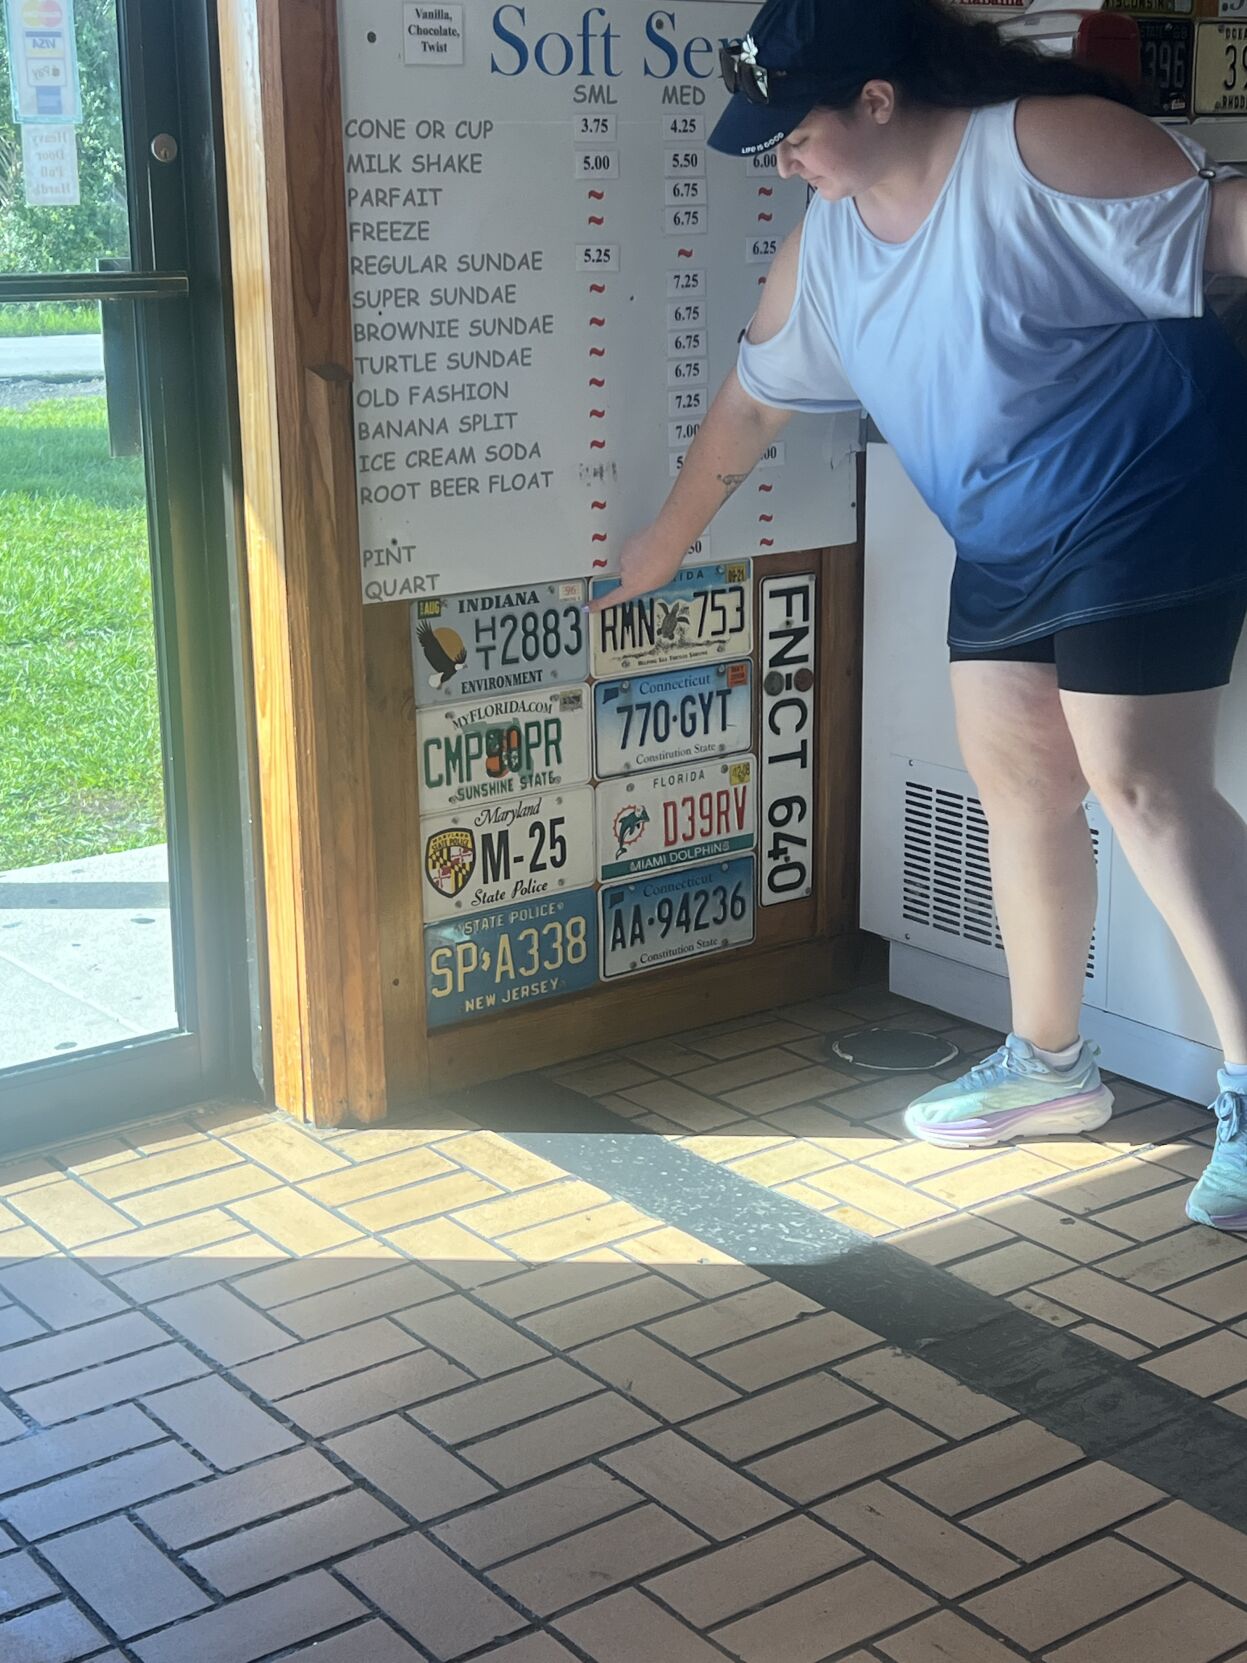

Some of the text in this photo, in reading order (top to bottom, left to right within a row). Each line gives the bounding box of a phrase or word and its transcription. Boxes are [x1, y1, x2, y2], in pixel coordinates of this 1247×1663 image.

[415, 8, 453, 21] Vanilla,
[408, 25, 460, 38] Chocolate,
[491, 4, 623, 77] Soft
[421, 41, 448, 53] Twist
[573, 85, 706, 105] SML MED
[345, 119, 493, 139] CONE OR CUP
[581, 118, 608, 134] 3.75
[670, 119, 696, 134] 4.25
[346, 153, 483, 174] MILK SHAKE
[584, 156, 610, 171] 5.00
[672, 154, 698, 168] 5.50
[753, 154, 777, 168] 6.00
[347, 188, 443, 207] PARFAIT
[673, 183, 698, 197] 6.75
[674, 211, 698, 225] 6.75
[349, 221, 430, 242] FREEZE
[584, 248, 611, 263] 5.25
[752, 241, 776, 255] 6.25
[350, 251, 543, 275] REGULAR SUNDAE
[674, 274, 699, 289] 7.25
[352, 284, 516, 309] SUPER SUNDAE
[675, 307, 699, 321] 6.75
[354, 314, 554, 343] BROWNIE SUNDAE
[675, 335, 699, 349] 6.75
[355, 347, 532, 375] TURTLE SUNDAE
[675, 363, 700, 377] 6.75
[356, 381, 509, 408] OLD FASHION
[675, 394, 700, 408] 7.25
[358, 412, 518, 441] BANANA SPLIT
[675, 424, 700, 440] 7.00
[359, 442, 541, 473] ICE CREAM SODA
[760, 446, 777, 460] .00
[361, 482, 420, 505] ROOT
[430, 477, 480, 498] BEER
[489, 471, 553, 494] FLOAT
[363, 545, 416, 568] PINT
[365, 574, 440, 600] QUART
[458, 590, 540, 614] INDIANA
[694, 586, 744, 638] 753
[461, 670, 543, 694] ENVIRONMENT
[639, 674, 710, 695] Connecticut
[636, 742, 716, 765] Constitution State
[457, 771, 554, 801] SUNSHINE STATE
[653, 769, 705, 788] FLORIDA
[475, 798, 542, 827] Maryland
[663, 785, 747, 847] D39RV
[481, 817, 567, 884] M-25
[630, 840, 730, 872] MIAMI DOLPHINS
[471, 878, 548, 906] State Police
[643, 873, 713, 897] Connecticut
[464, 903, 557, 935] STATE POLICE
[640, 938, 719, 965] Constitution State
[465, 977, 558, 1012] NEW JERSEY
